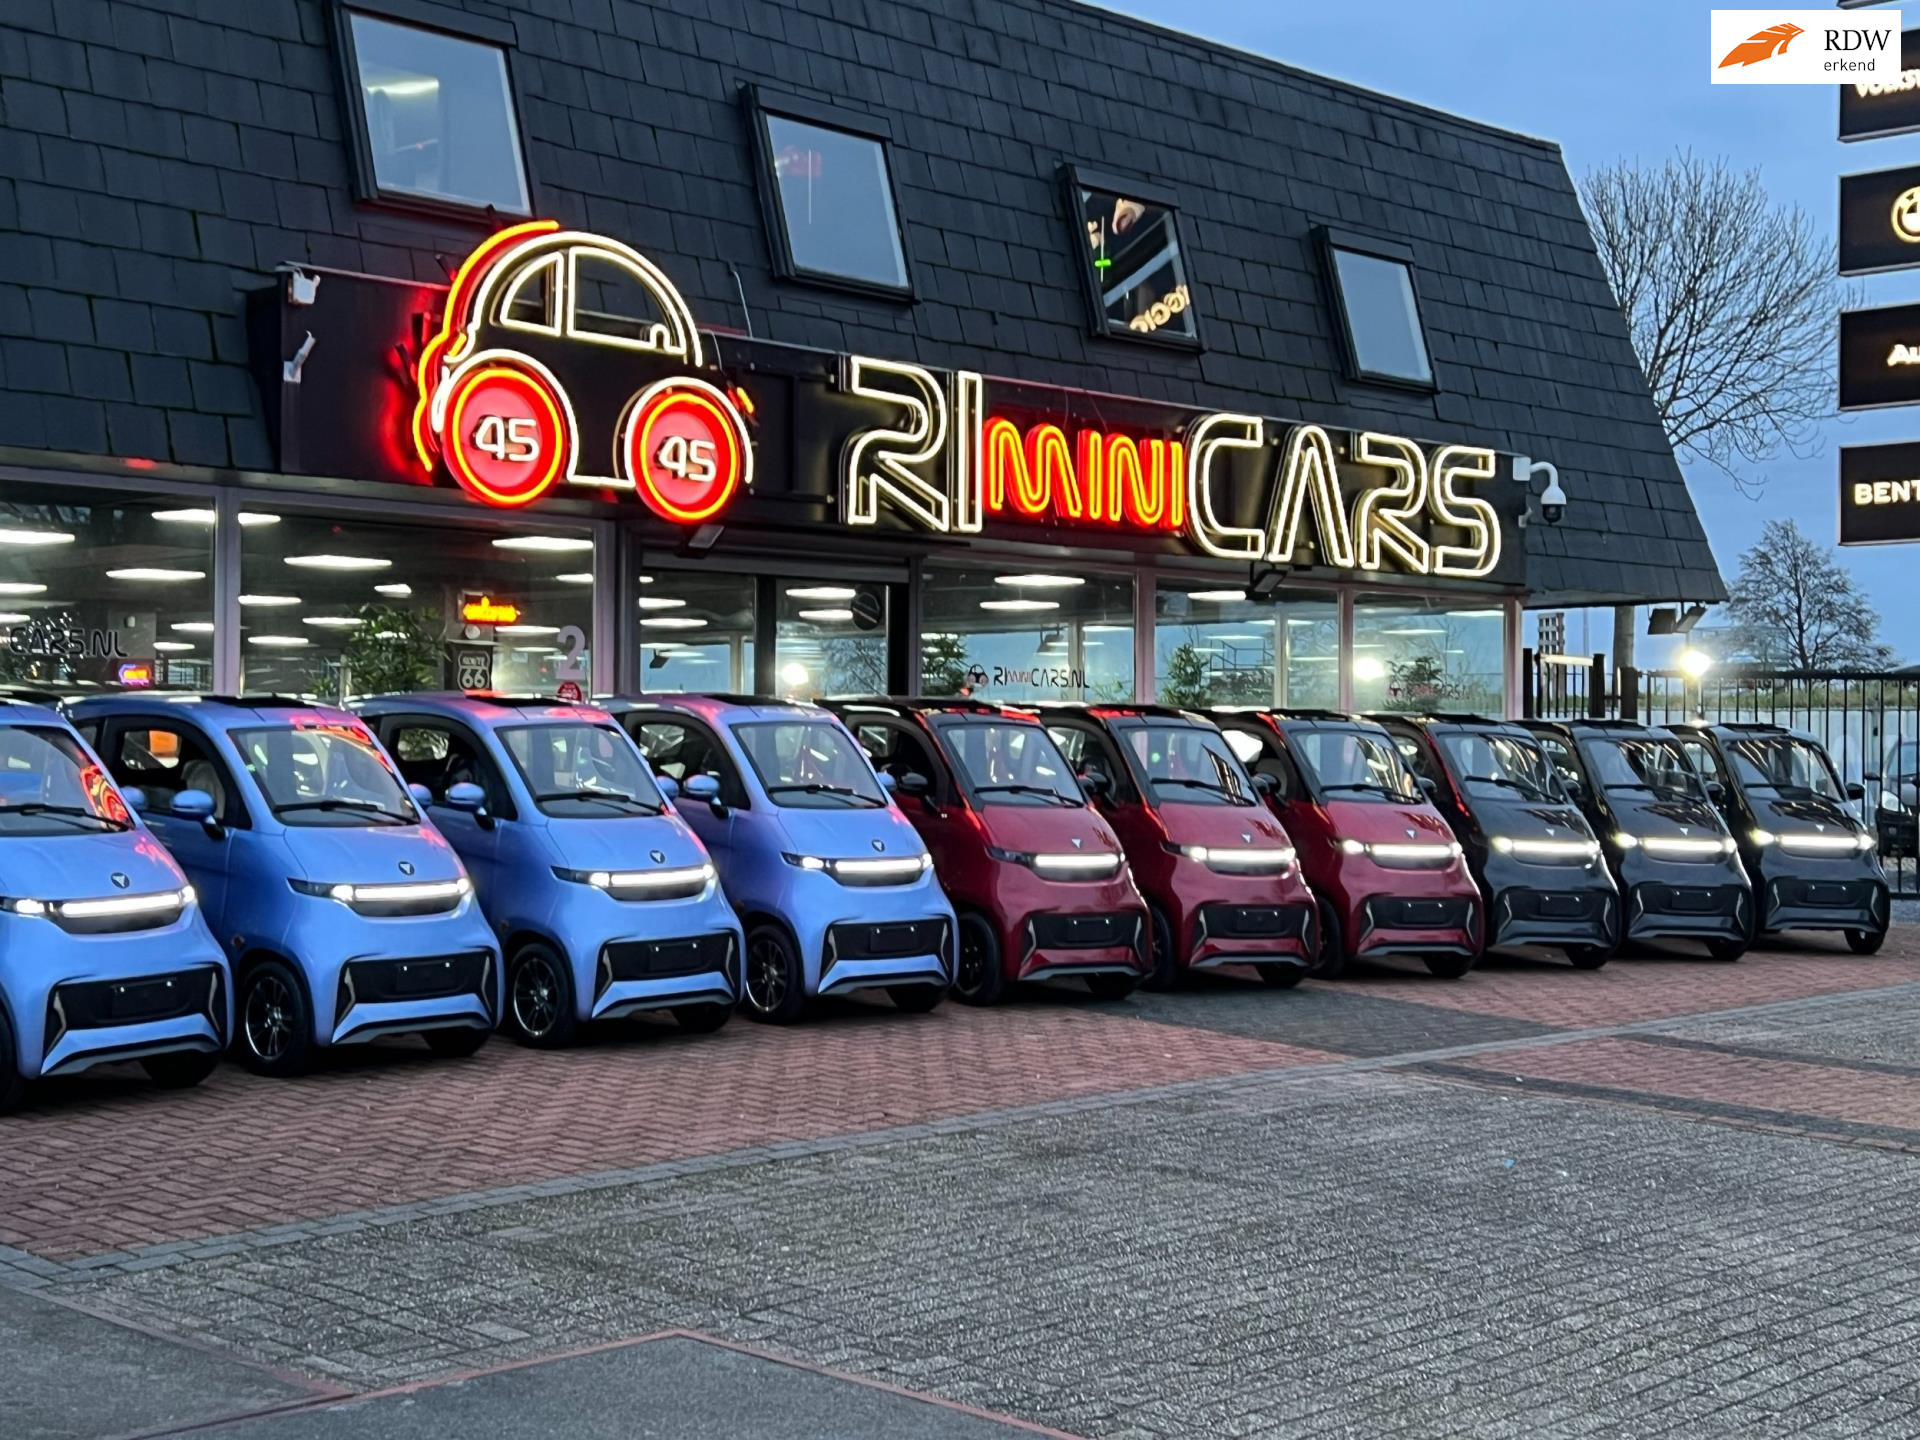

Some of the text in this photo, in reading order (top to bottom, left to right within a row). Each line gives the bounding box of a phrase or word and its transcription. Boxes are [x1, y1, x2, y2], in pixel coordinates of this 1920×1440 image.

[474, 415, 541, 462] 45
[657, 435, 717, 482] 45
[555, 625, 586, 679] 2
[461, 669, 486, 689] 66
